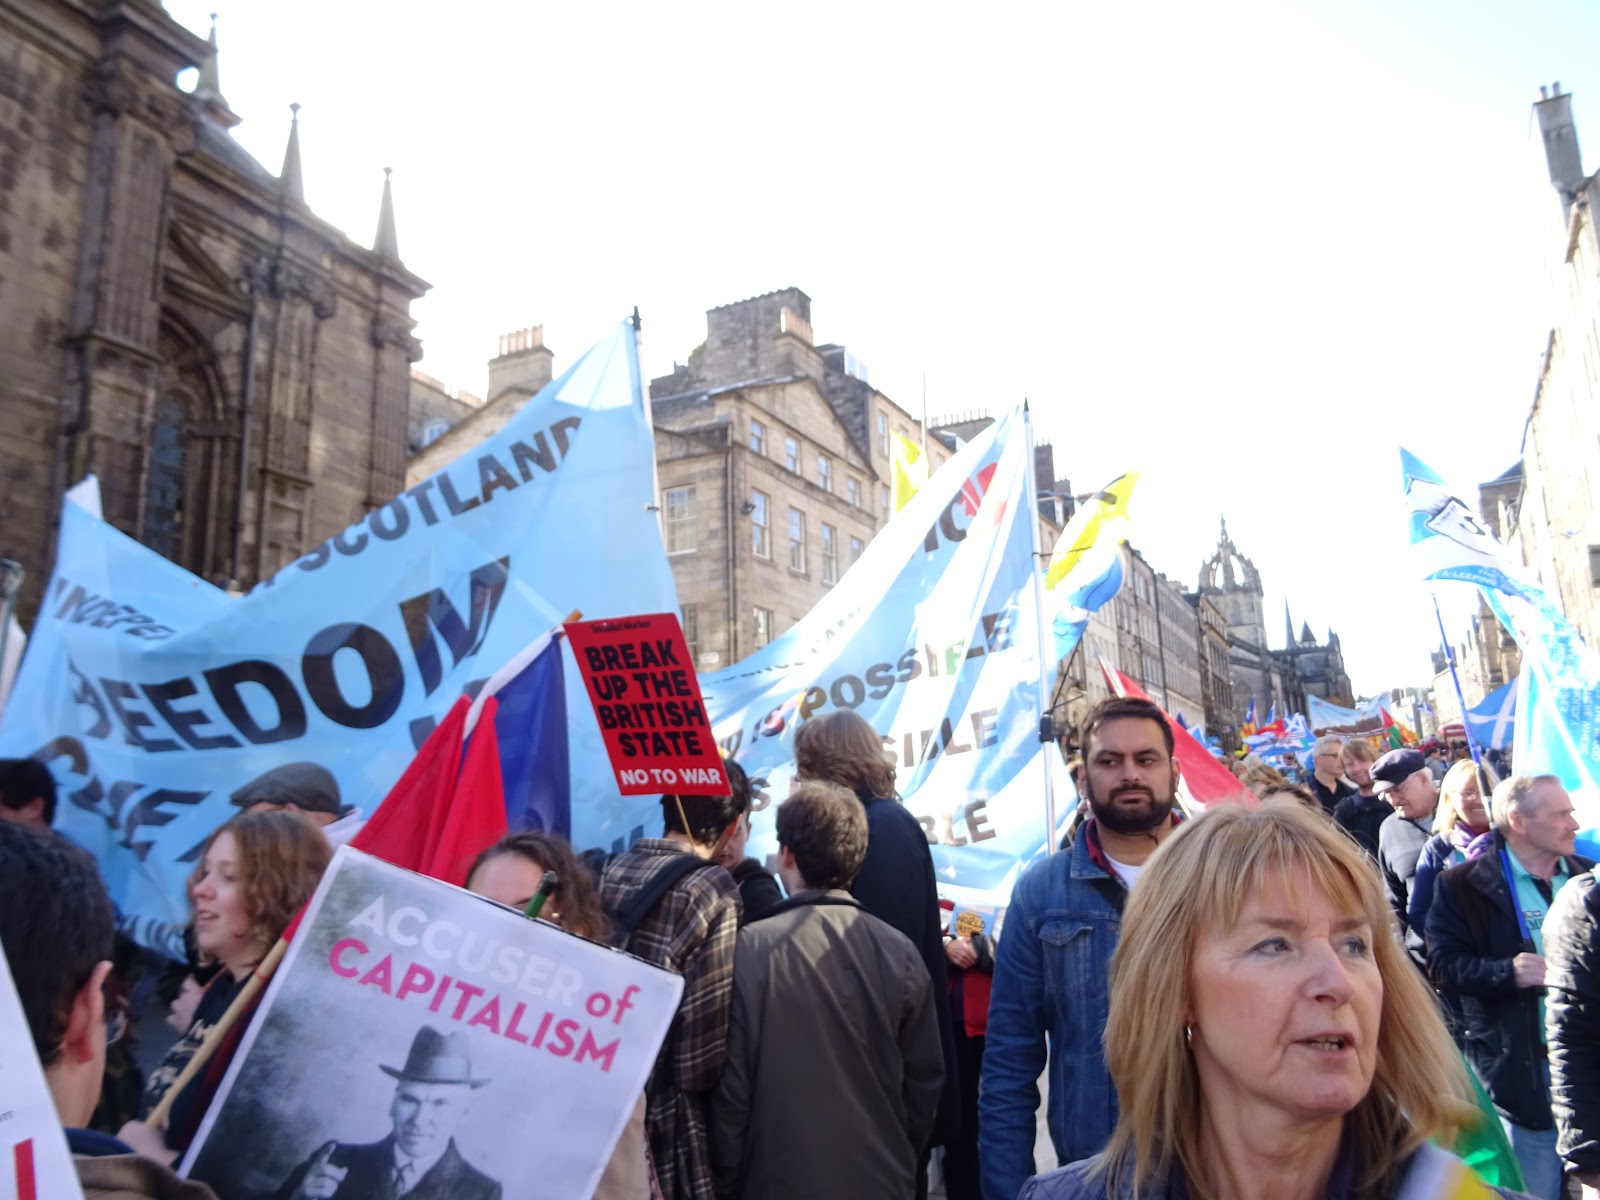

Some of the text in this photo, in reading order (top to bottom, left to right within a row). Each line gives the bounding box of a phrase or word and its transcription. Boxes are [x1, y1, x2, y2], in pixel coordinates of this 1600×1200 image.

[297, 416, 583, 571] SCOTLAND
[68, 555, 511, 753] EEDOM
[584, 639, 680, 672] BREAK
[592, 670, 692, 700] UP THE
[597, 701, 705, 729] BRITISH
[618, 730, 704, 757] STATE
[620, 768, 722, 785] NO TO WAR
[349, 894, 641, 1025] ACCUSER of
[327, 937, 622, 1073] CAPITALISM
